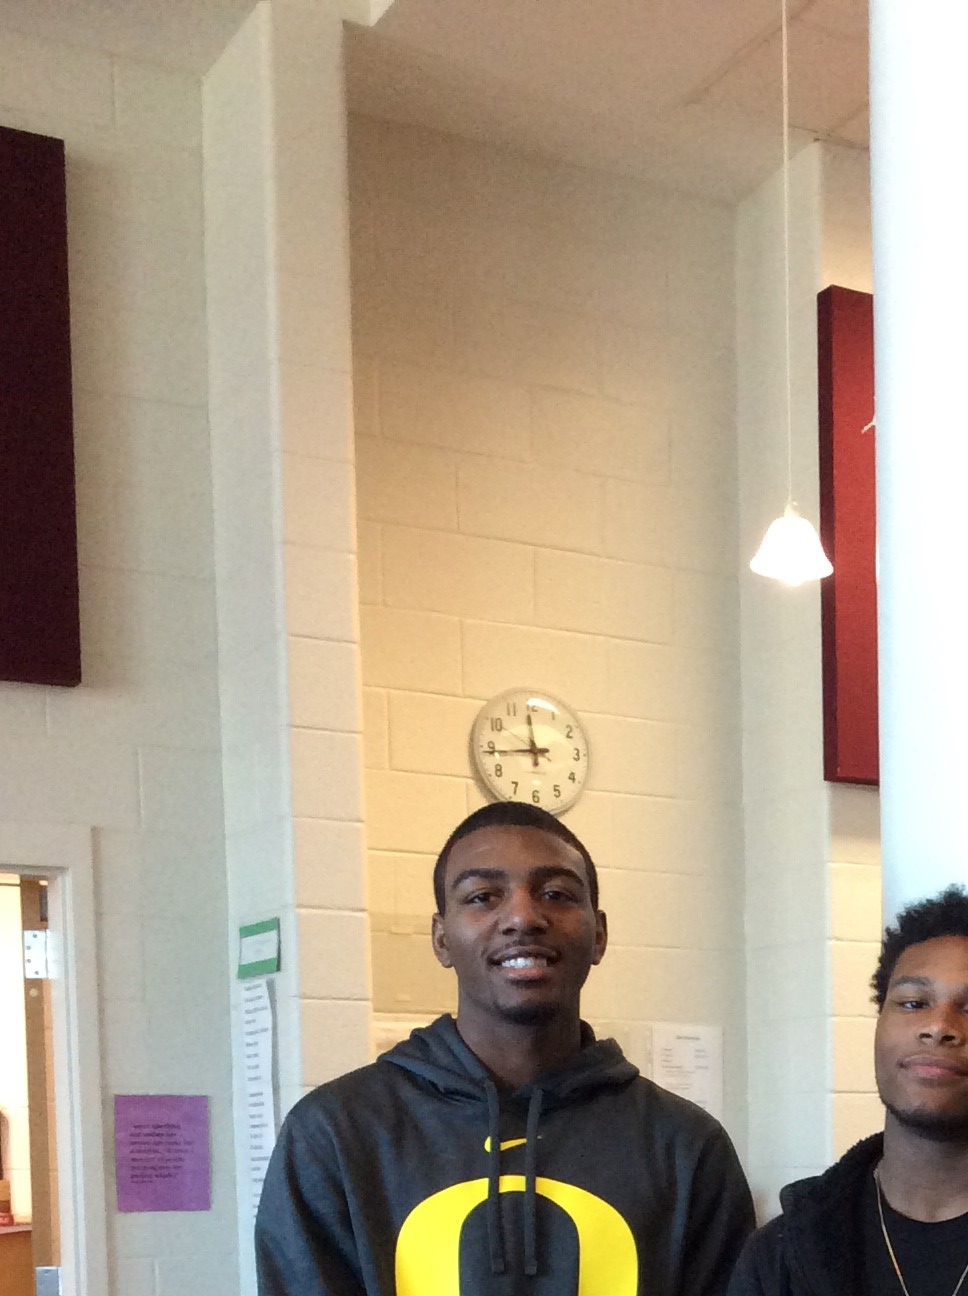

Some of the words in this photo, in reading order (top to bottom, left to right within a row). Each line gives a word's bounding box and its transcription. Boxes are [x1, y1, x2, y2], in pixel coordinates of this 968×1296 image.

[506, 703, 516, 717] 11
[490, 718, 502, 732] 10
[566, 725, 574, 739] 2
[488, 741, 496, 754] 9
[572, 748, 580, 762] 3
[494, 764, 502, 778] 8
[568, 772, 576, 784] 4
[512, 781, 518, 796] 7
[554, 785, 562, 798] 5
[532, 790, 540, 804] 6
